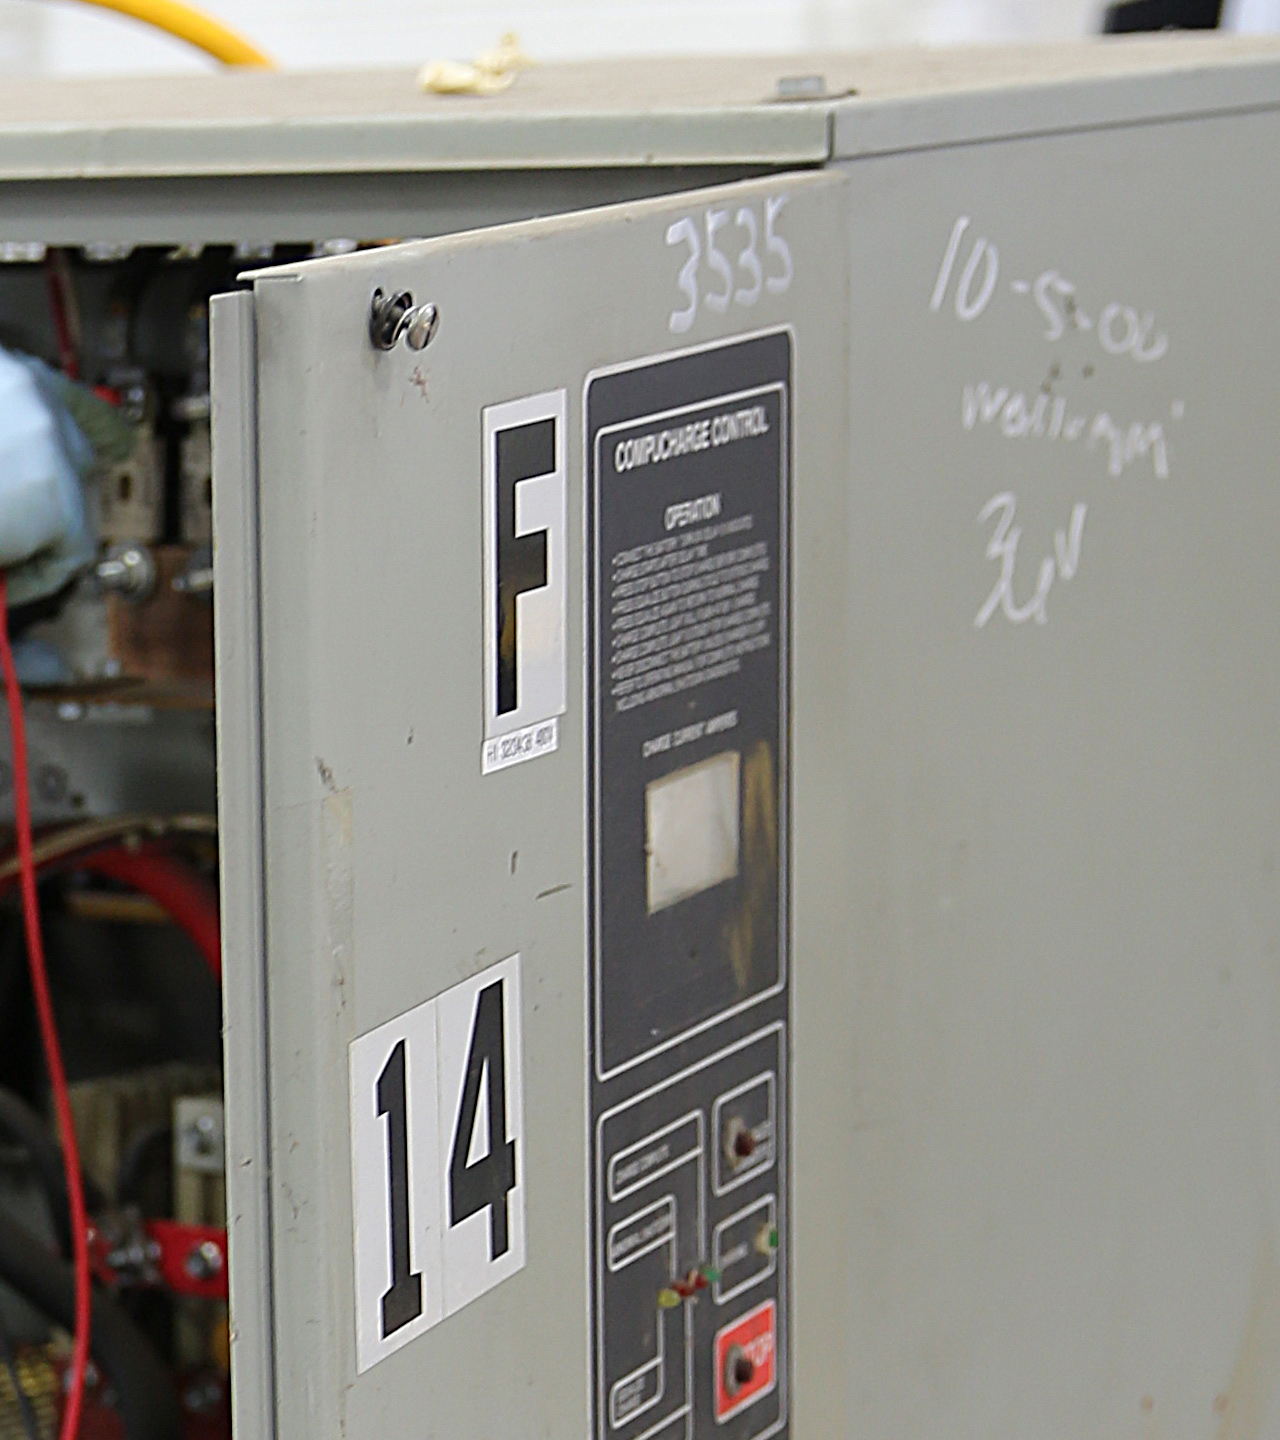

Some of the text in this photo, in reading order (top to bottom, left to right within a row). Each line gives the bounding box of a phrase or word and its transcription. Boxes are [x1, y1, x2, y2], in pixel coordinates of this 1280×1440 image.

[665, 192, 794, 334] 3535
[615, 406, 770, 473] COMPUCHARGE CONTROL
[665, 493, 721, 531] OPERATION
[496, 417, 556, 716] F
[376, 978, 517, 1341] 14
[741, 1331, 772, 1366] TOP
